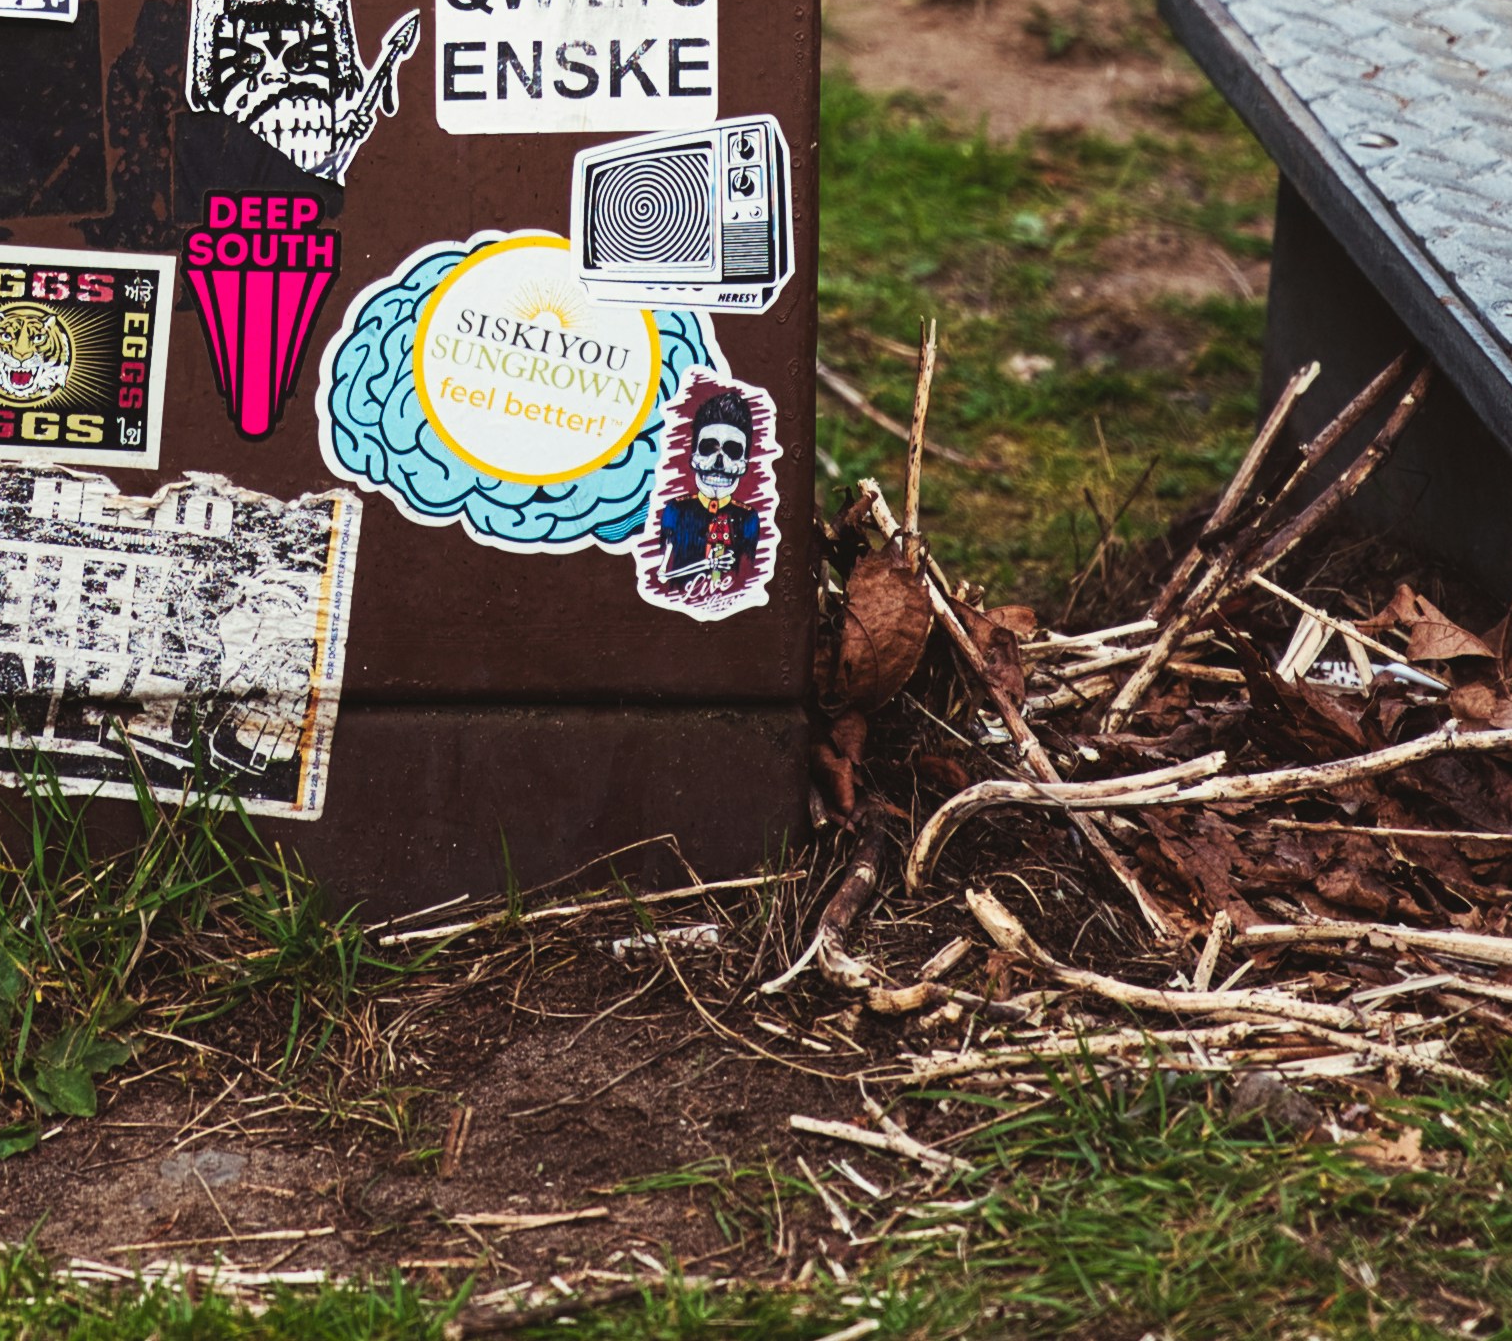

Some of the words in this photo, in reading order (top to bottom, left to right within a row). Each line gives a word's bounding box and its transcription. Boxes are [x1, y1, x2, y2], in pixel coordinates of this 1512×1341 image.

[443, 37, 712, 101] ENSKE
[208, 196, 320, 230] DEEP
[188, 232, 335, 268] SOUTH
[717, 291, 758, 305] HERESY
[118, 311, 151, 410] EGGS
[431, 333, 642, 407] SUNGROWN
[457, 308, 632, 372] SISKIYOU
[440, 376, 497, 410] feel
[504, 391, 607, 438] better!
[337, 519, 352, 589] INTERNATIONAL
[334, 591, 343, 613] AND
[328, 615, 340, 662] DOMESTIC
